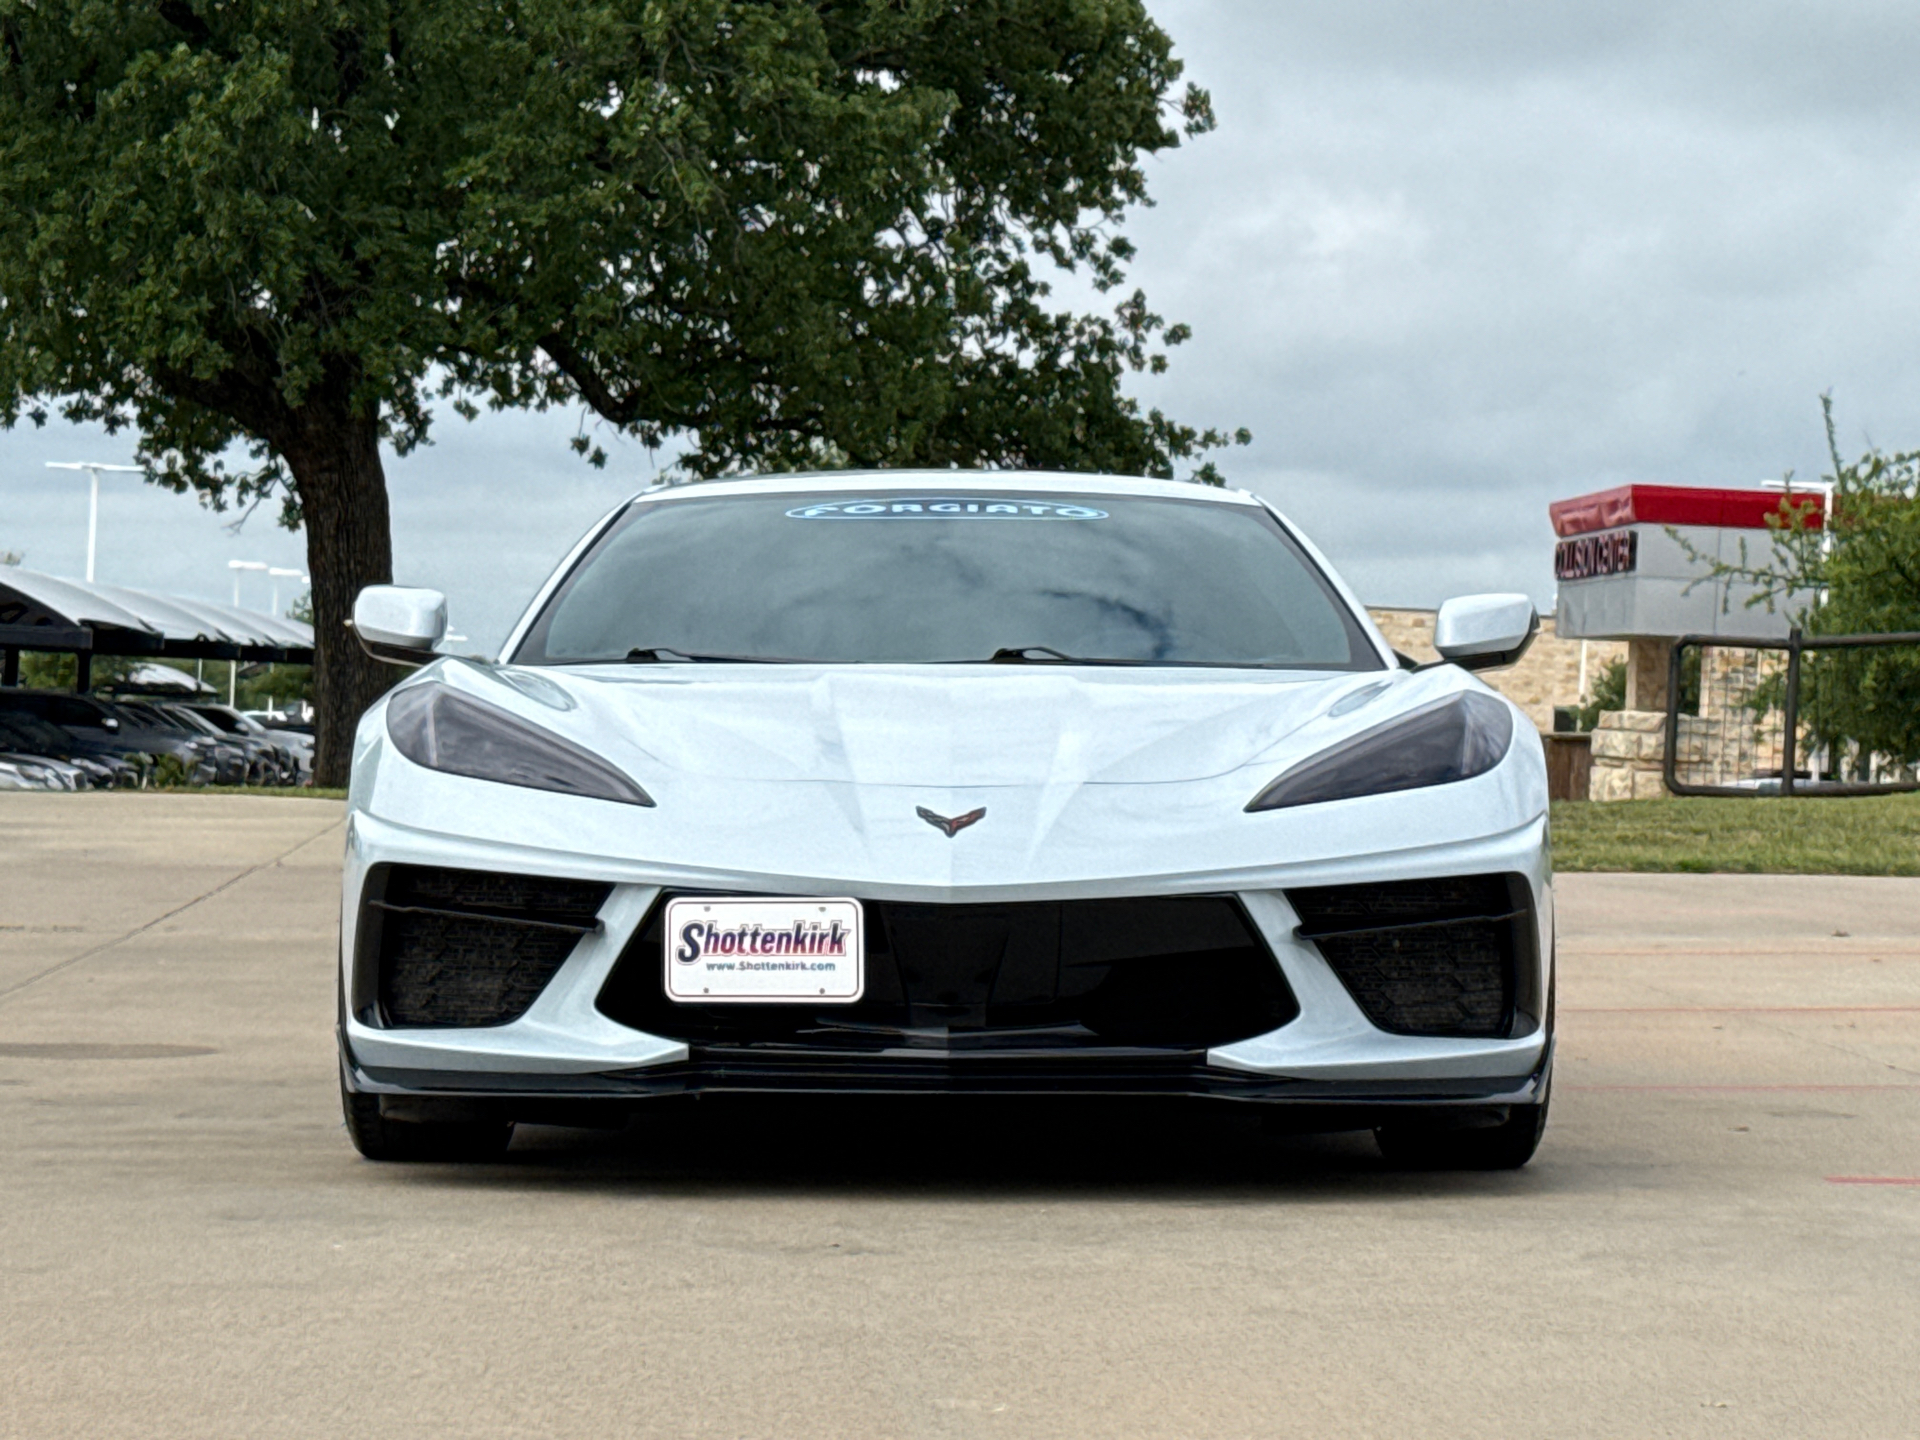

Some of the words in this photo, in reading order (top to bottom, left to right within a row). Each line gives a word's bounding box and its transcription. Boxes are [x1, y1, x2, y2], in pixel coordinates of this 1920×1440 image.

[803, 503, 1099, 519] FORGIATO
[677, 921, 848, 963] Shottenkirk
[706, 961, 836, 971] www.Shottenkirk.com
